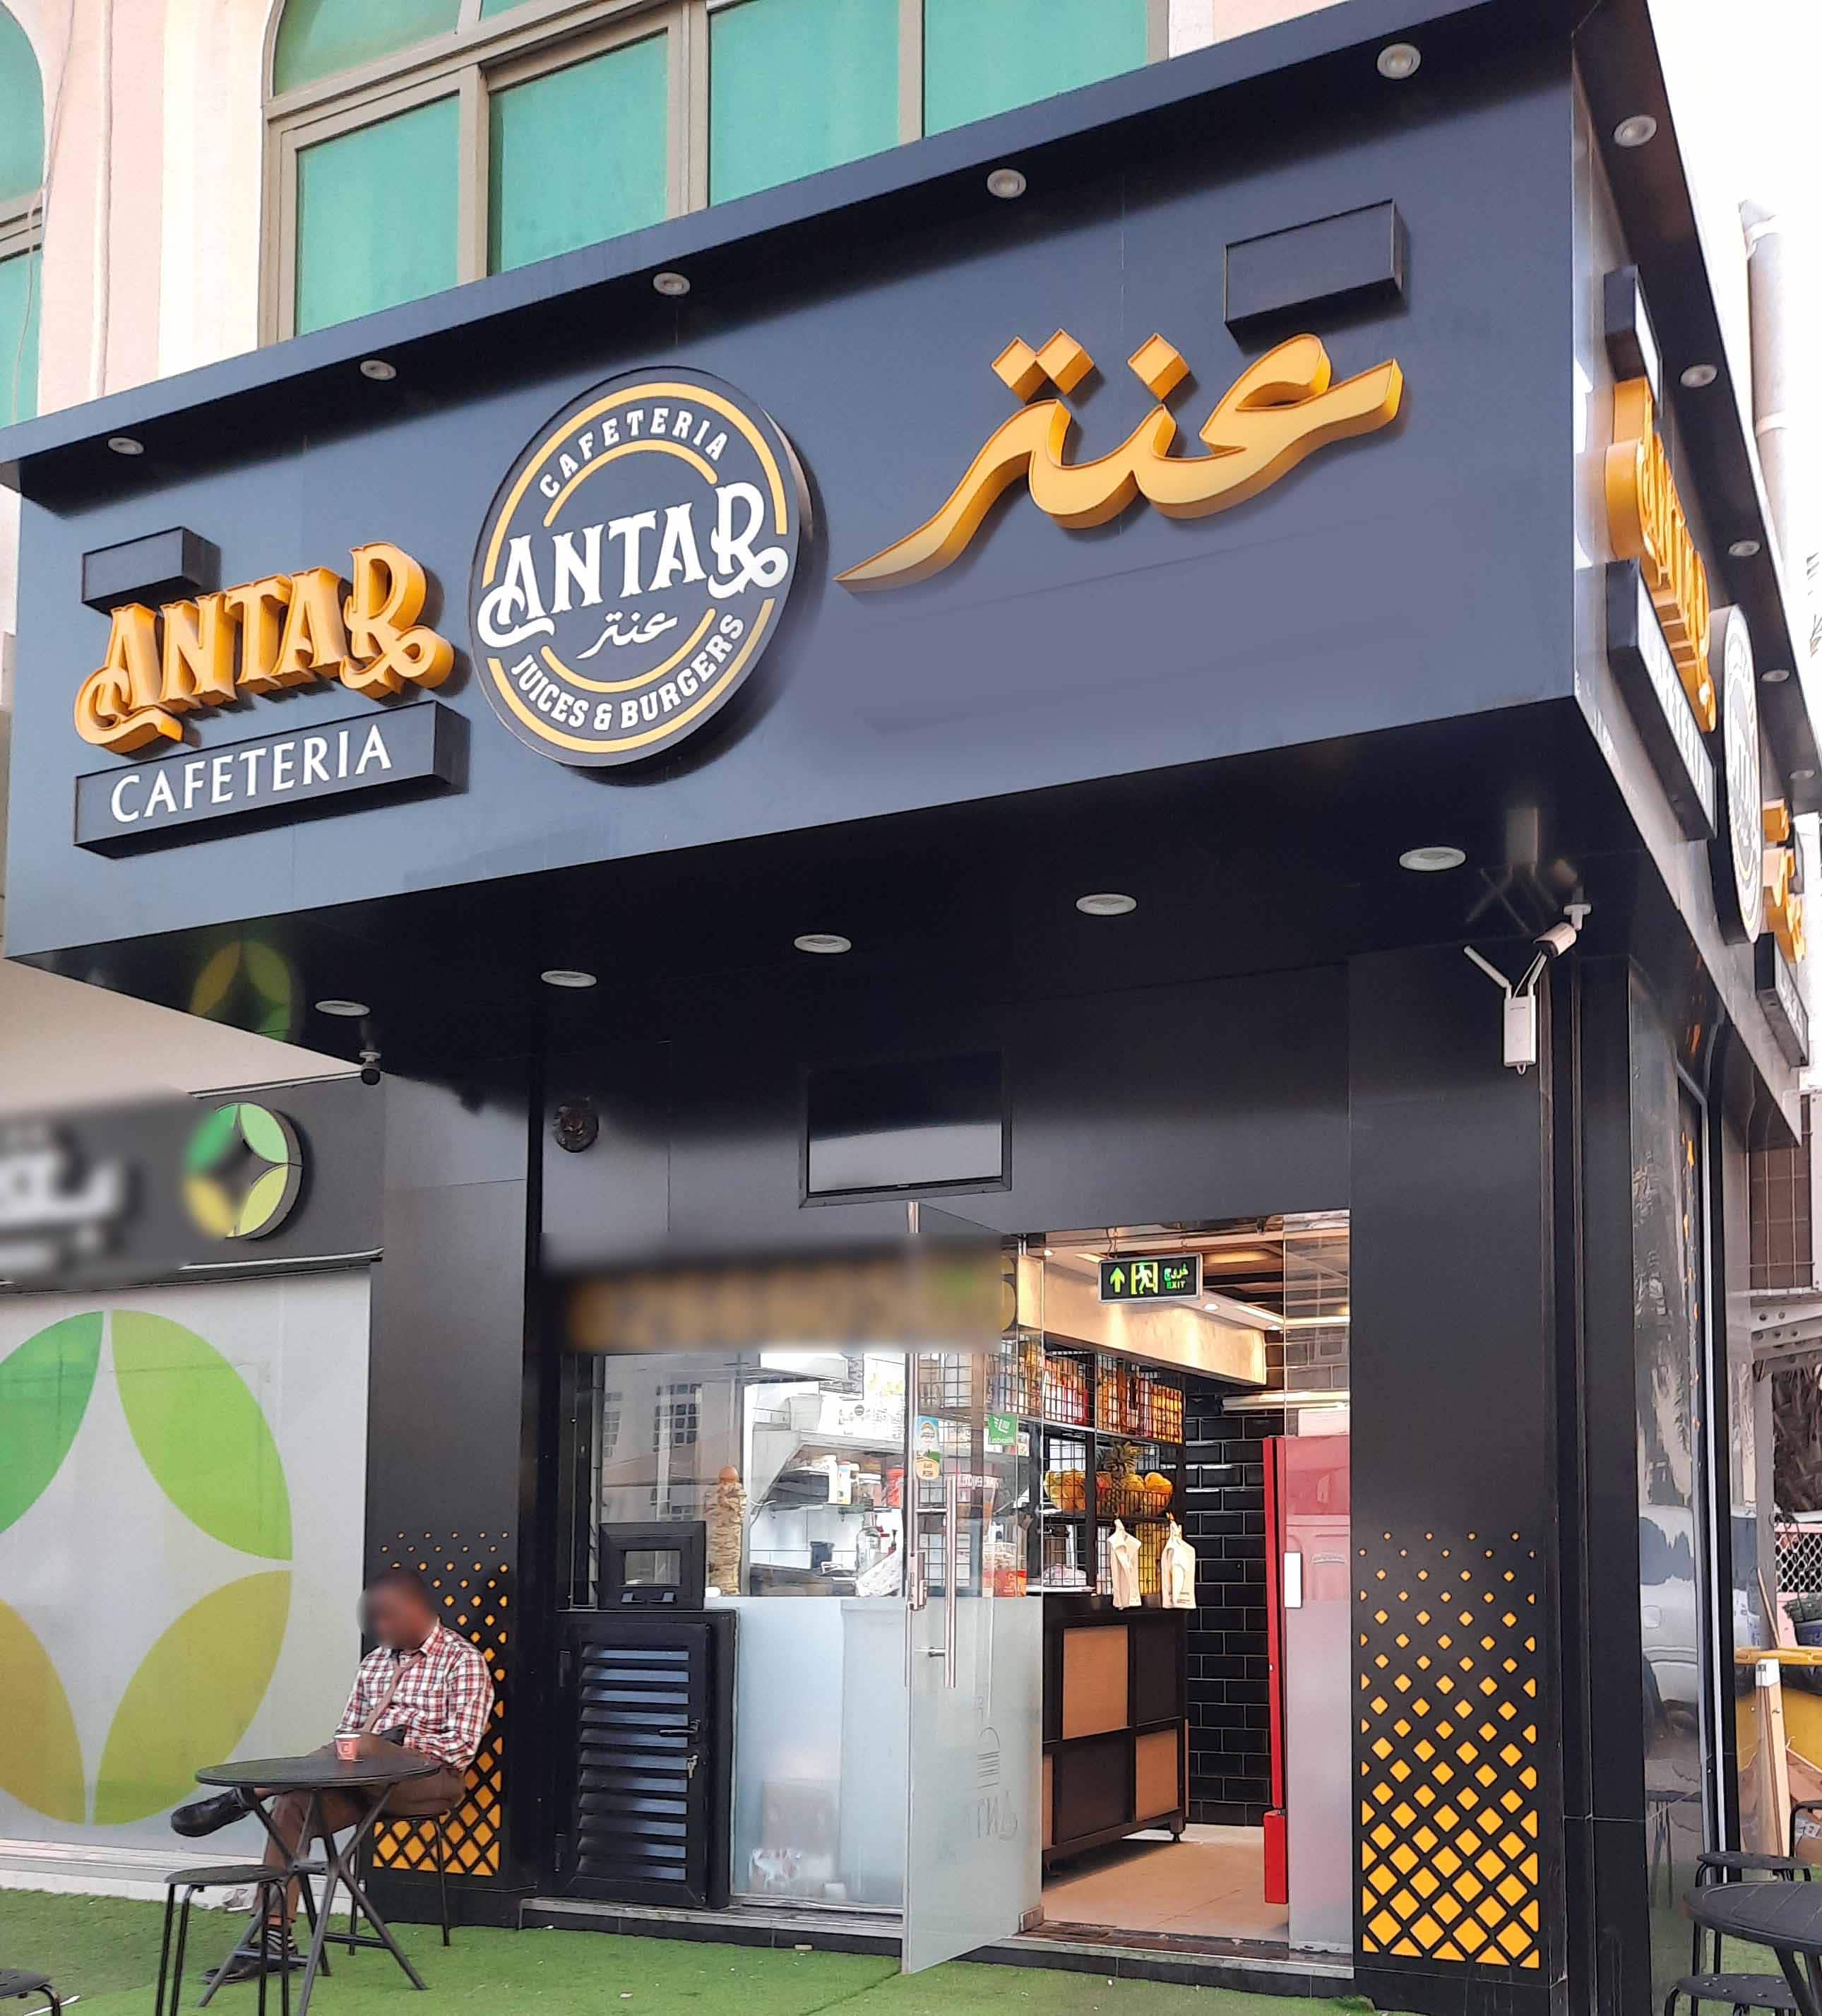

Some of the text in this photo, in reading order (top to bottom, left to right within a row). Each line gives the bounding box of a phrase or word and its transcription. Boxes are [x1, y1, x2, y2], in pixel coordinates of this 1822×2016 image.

[539, 407, 728, 499] CAFETERIA
[833, 328, 1405, 594] عنتر
[477, 481, 789, 648] ANTAR
[73, 542, 454, 754] ANTAR
[510, 613, 744, 731] JUICES & BURGERS
[576, 610, 678, 659] عنتر
[110, 723, 393, 824] CAFETERIA
[1166, 1280, 1186, 1289] EXIT
